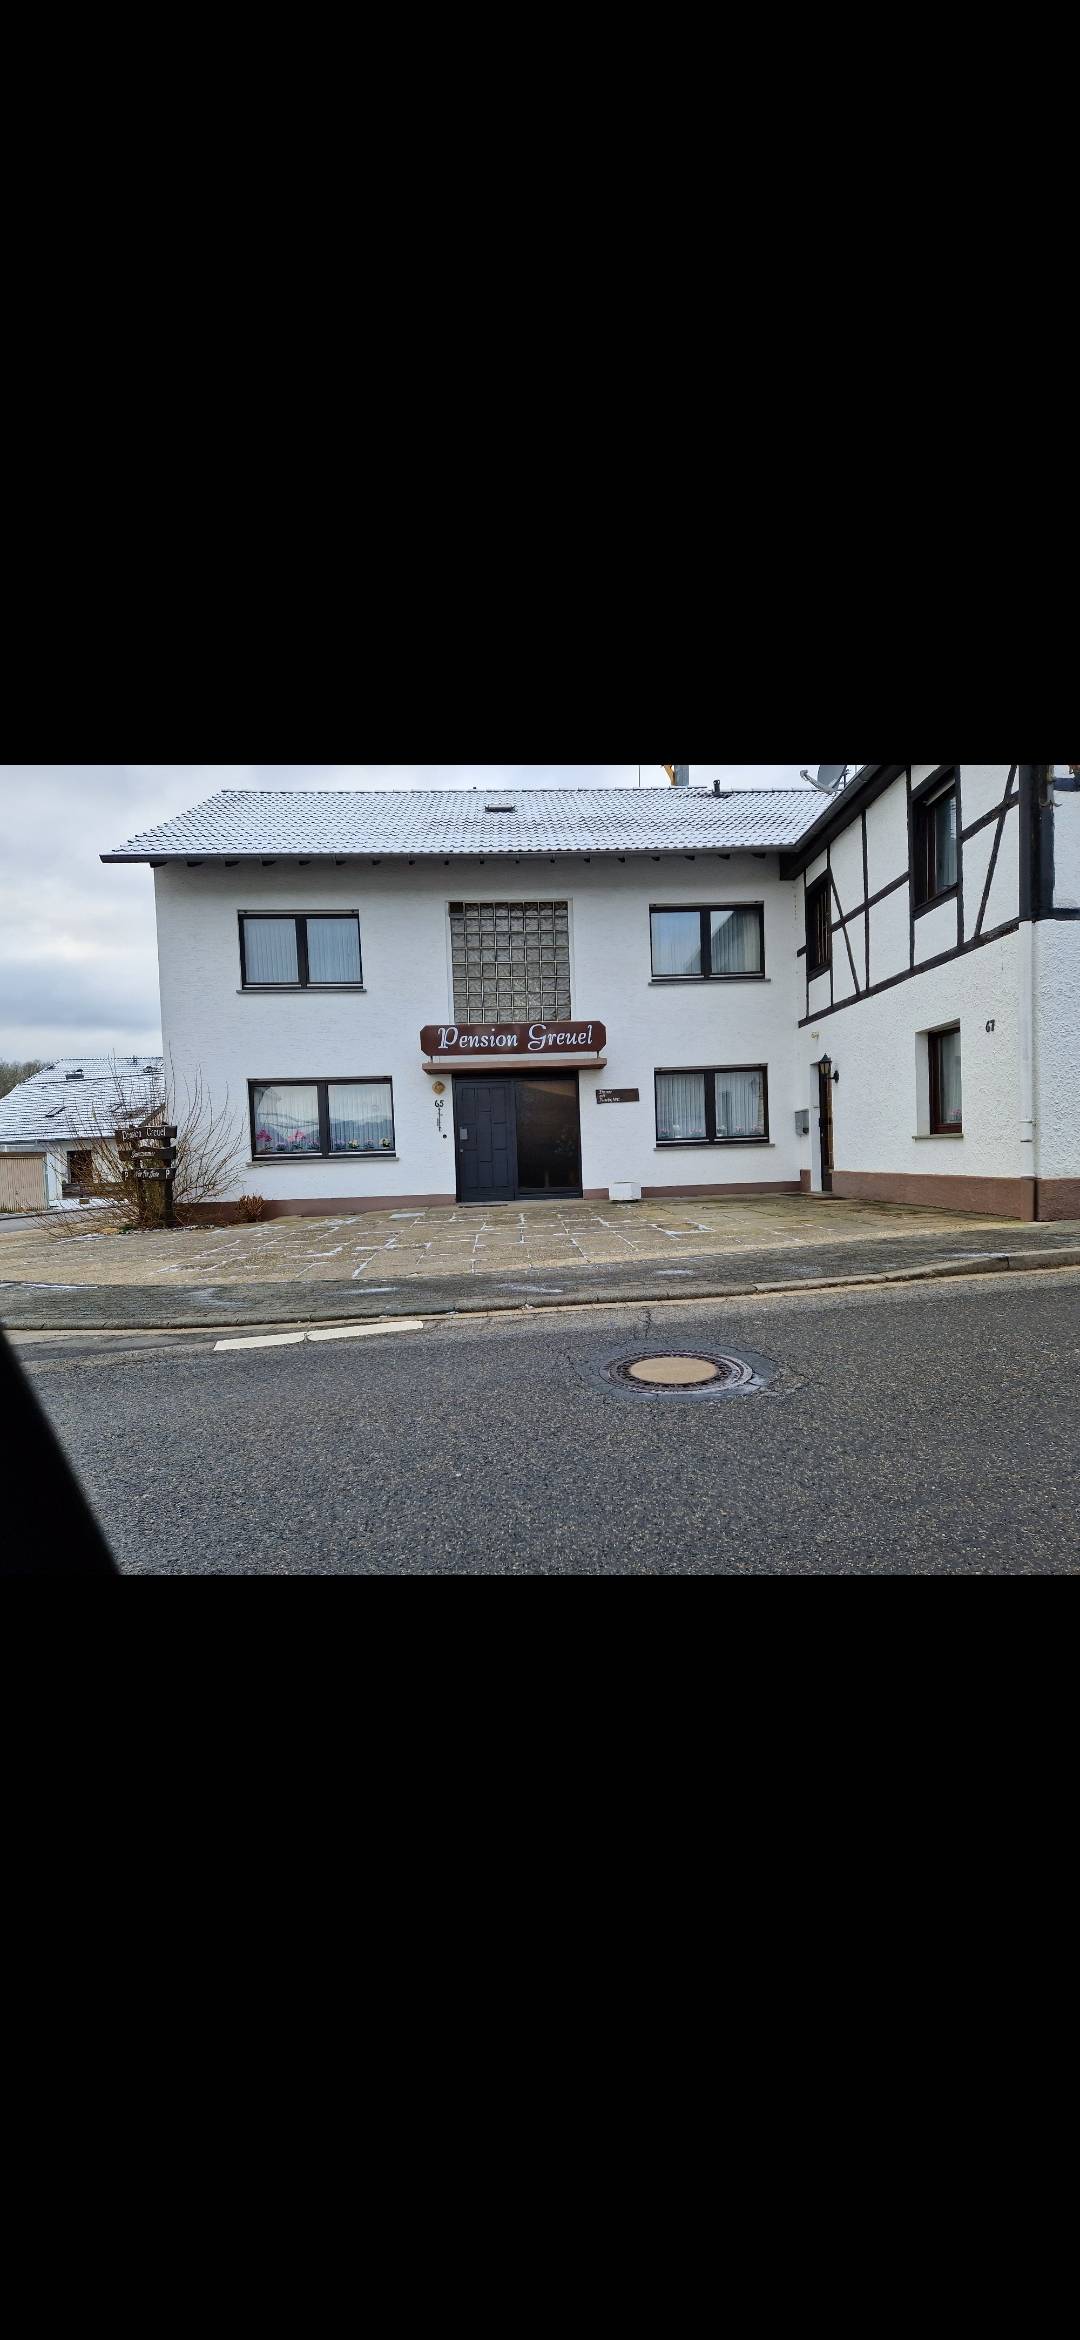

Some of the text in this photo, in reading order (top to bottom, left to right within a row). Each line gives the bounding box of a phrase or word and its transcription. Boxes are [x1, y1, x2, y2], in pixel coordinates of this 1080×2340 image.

[985, 1019, 995, 1033] 67
[438, 1023, 593, 1051] Pension Greuel
[434, 1099, 444, 1108] 65
